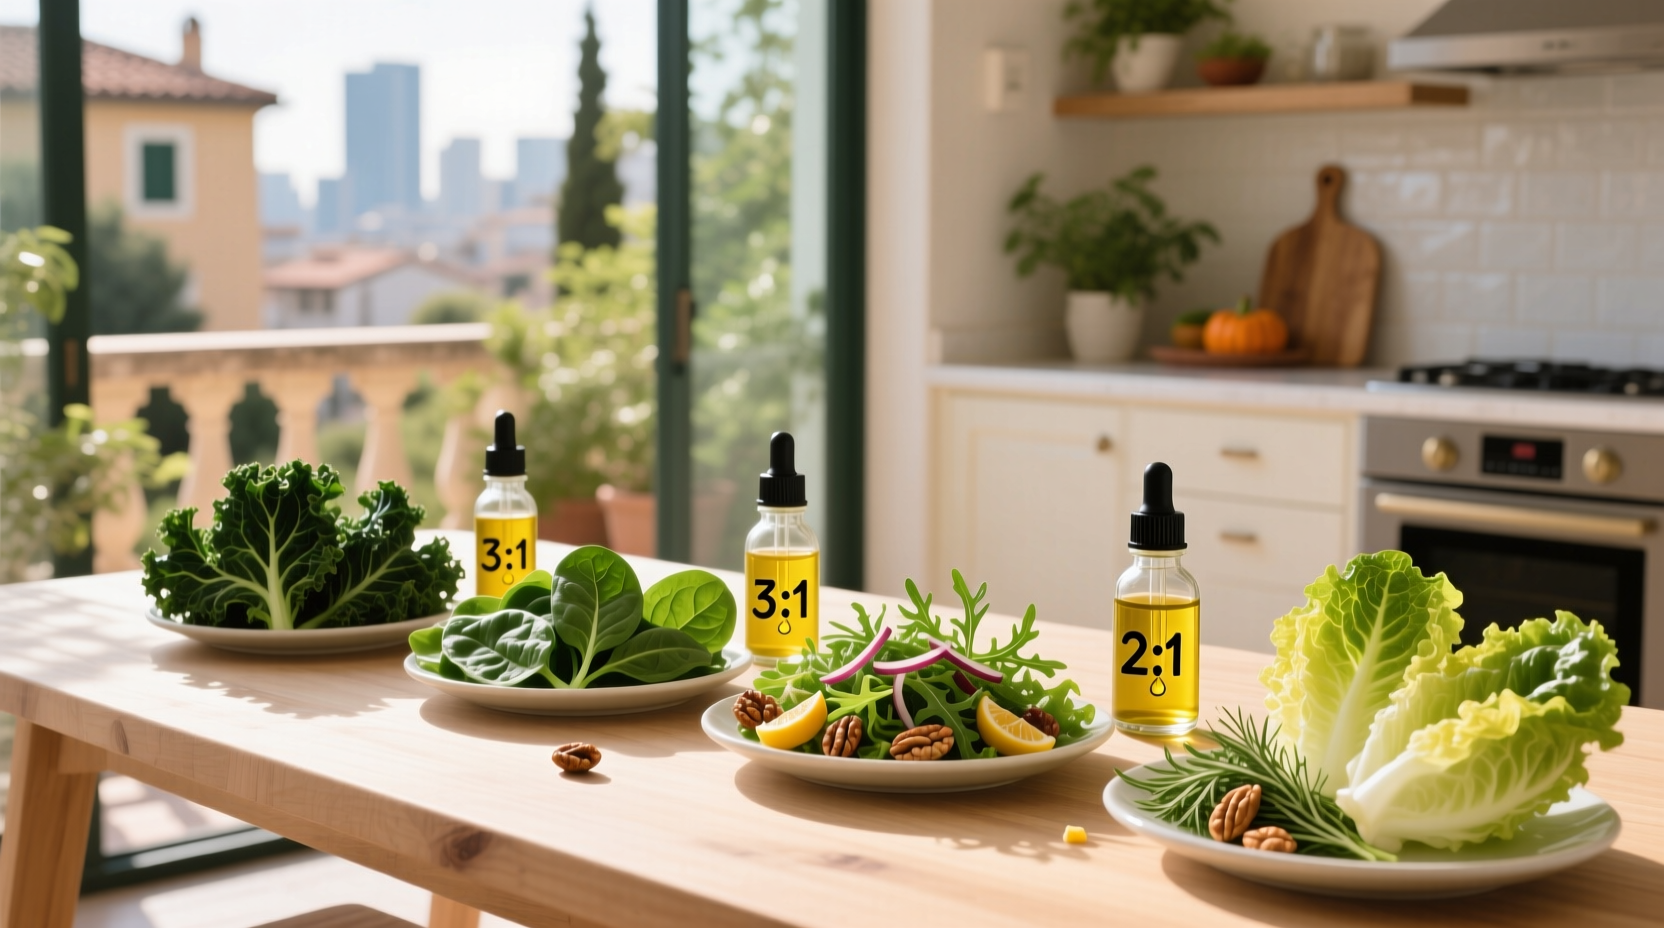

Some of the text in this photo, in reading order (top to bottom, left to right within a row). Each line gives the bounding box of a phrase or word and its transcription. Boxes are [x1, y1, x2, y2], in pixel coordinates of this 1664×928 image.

[481, 538, 527, 572] 3:1
[752, 579, 808, 619] 3:1
[1121, 630, 1182, 677] 2:1
